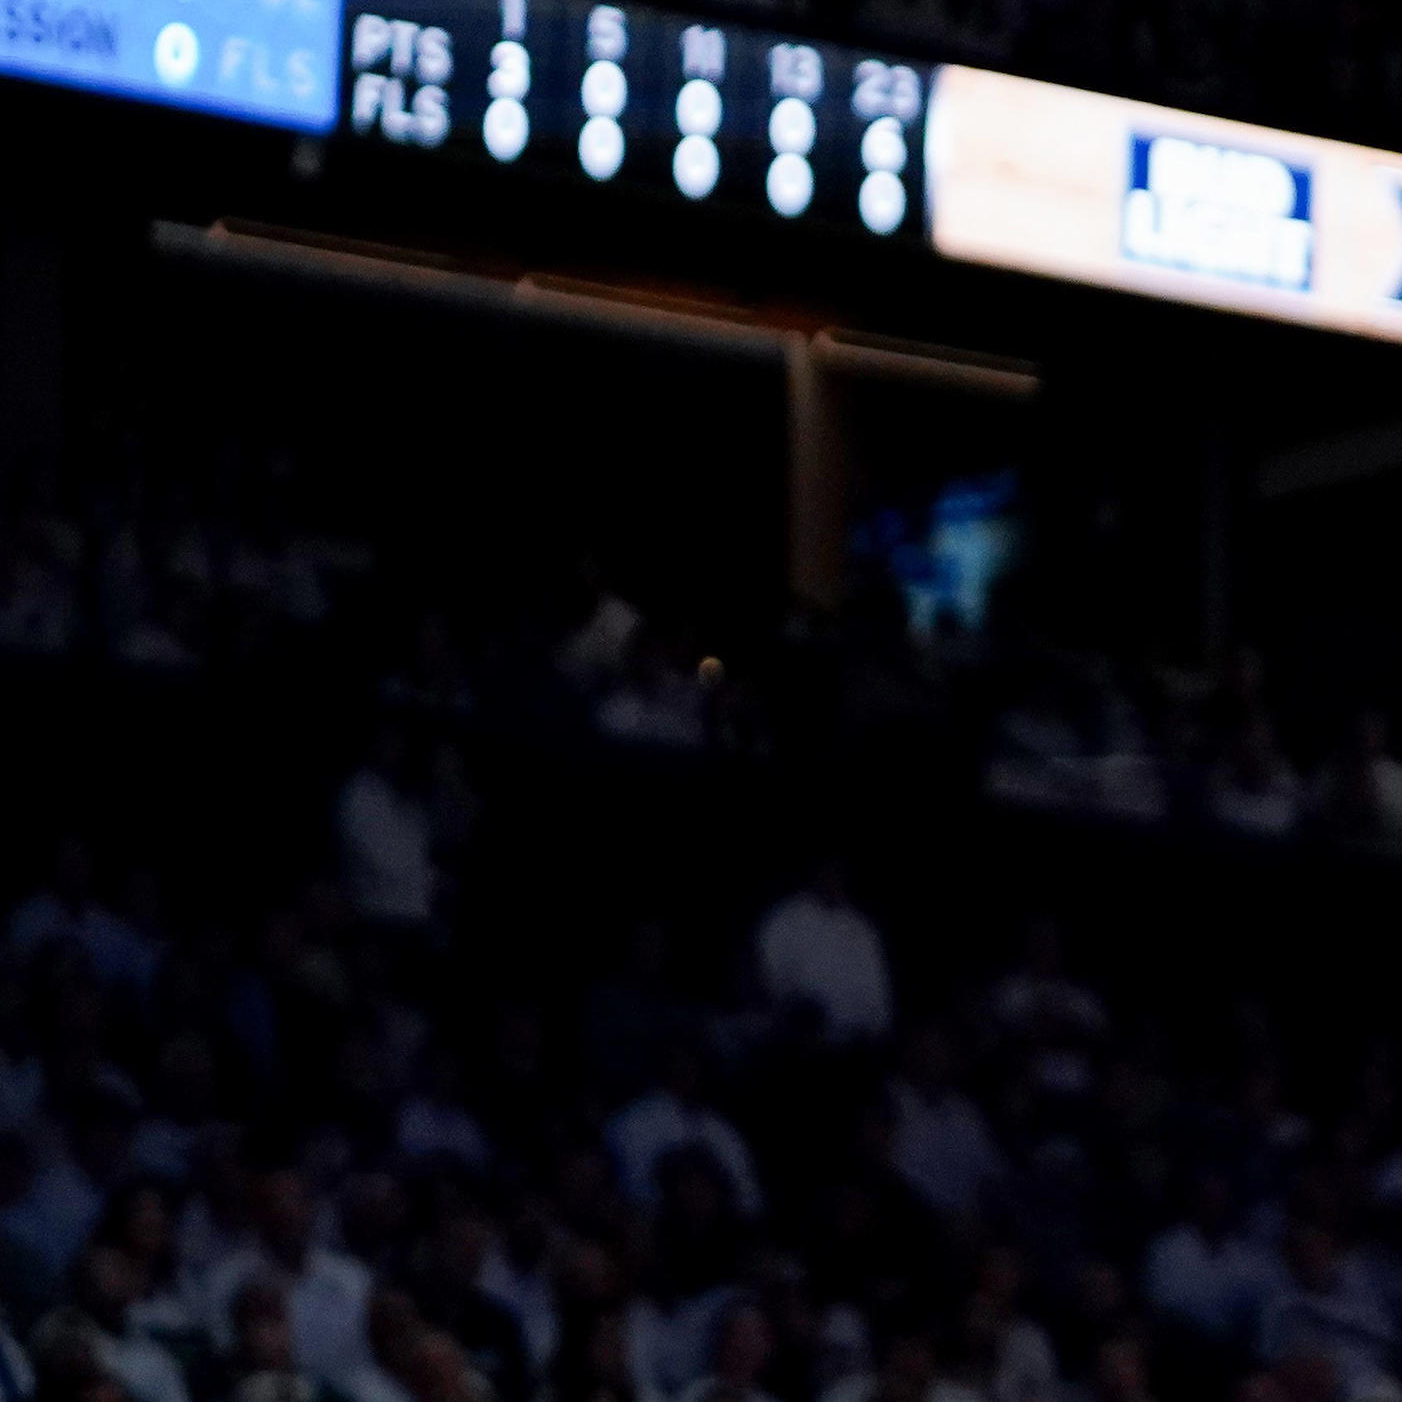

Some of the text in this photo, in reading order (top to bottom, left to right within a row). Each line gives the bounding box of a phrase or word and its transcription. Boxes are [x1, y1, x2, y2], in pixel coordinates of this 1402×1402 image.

[154, 22, 199, 88] 0
[353, 12, 453, 85] PTS
[353, 72, 450, 147] FLS
